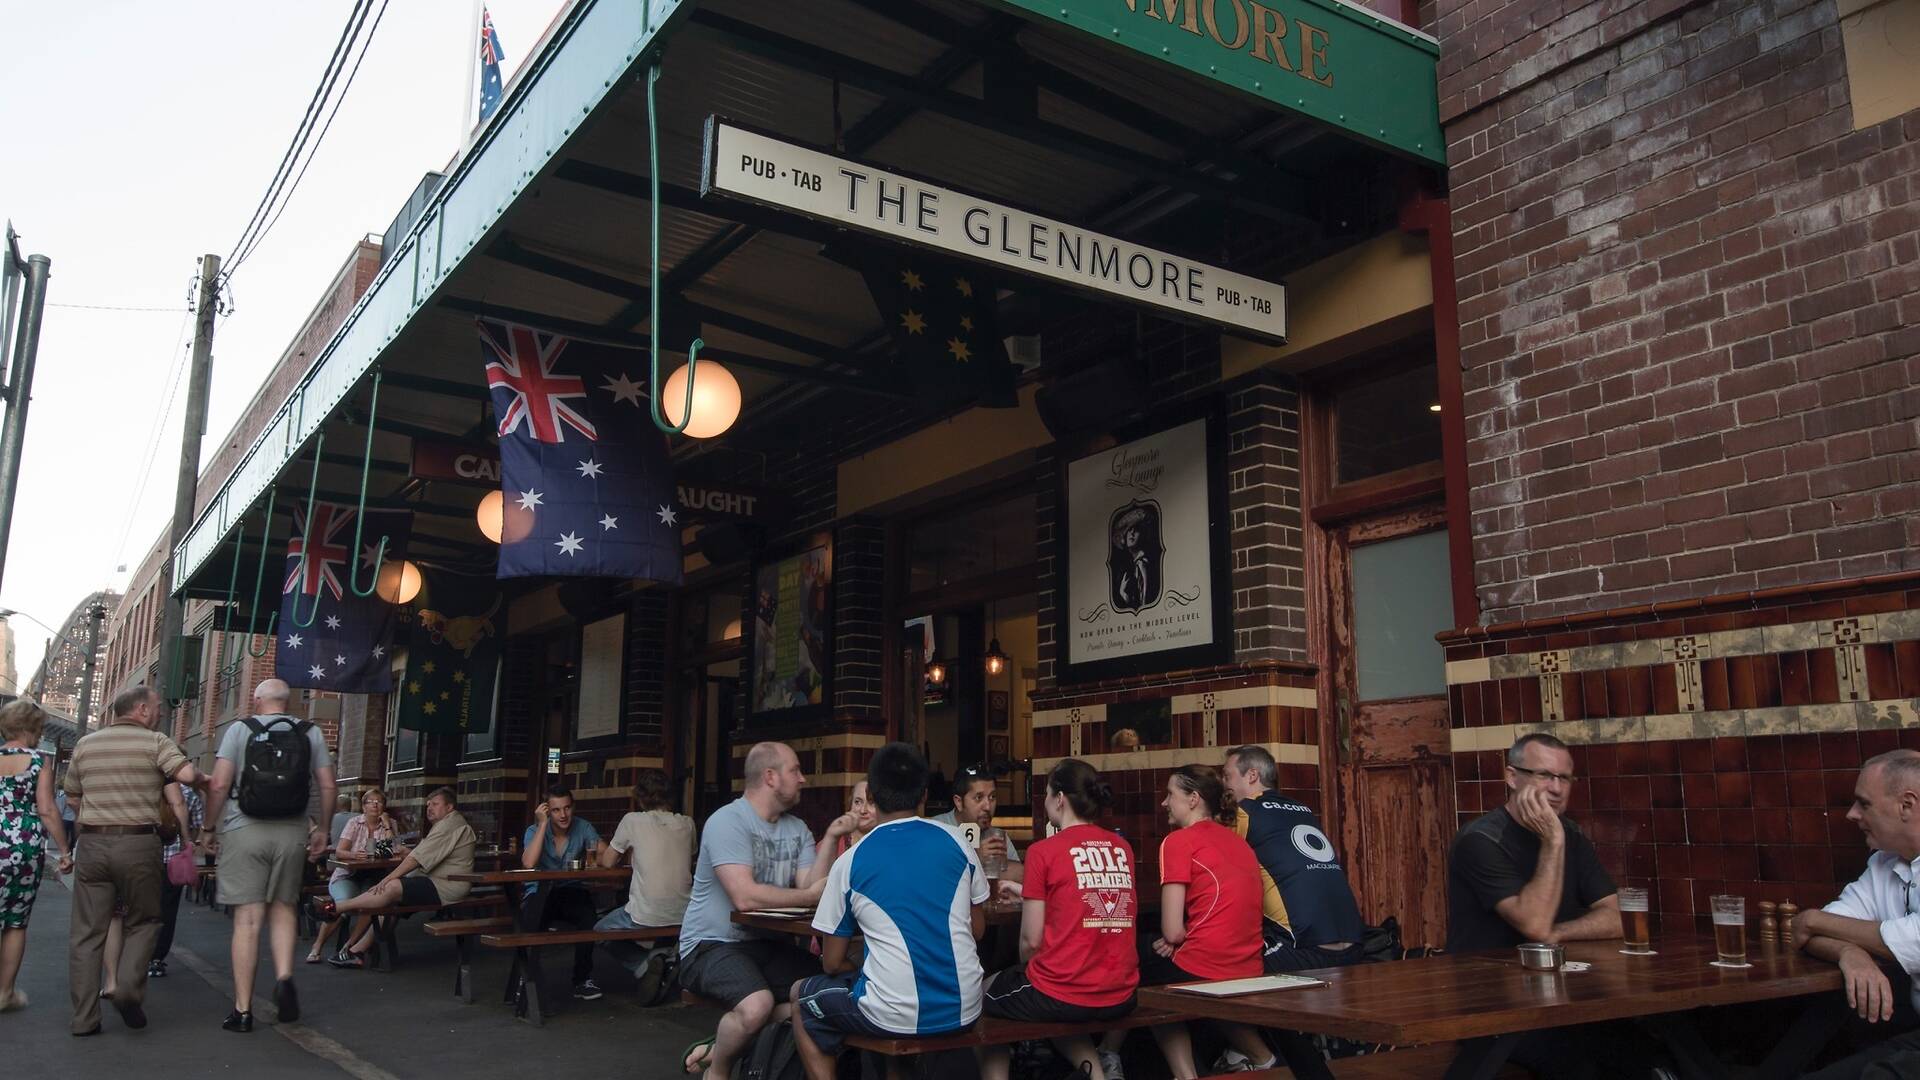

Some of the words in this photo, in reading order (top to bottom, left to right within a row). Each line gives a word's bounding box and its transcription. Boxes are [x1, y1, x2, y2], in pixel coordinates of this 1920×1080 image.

[1124, 0, 1334, 88] MORE
[740, 154, 776, 180] PUB
[791, 168, 822, 193] TAB
[837, 166, 940, 235] THE
[962, 206, 1205, 305] GLENMORE
[1216, 286, 1241, 307] PUB
[1250, 296, 1272, 315] TAB
[676, 484, 757, 516] AUGHT
[1177, 611, 1201, 622] LEVEL
[1261, 801, 1312, 814] ca.com
[965, 828, 974, 843] 6
[1069, 847, 1130, 873] 2012
[1076, 872, 1132, 890] PREMIERS
